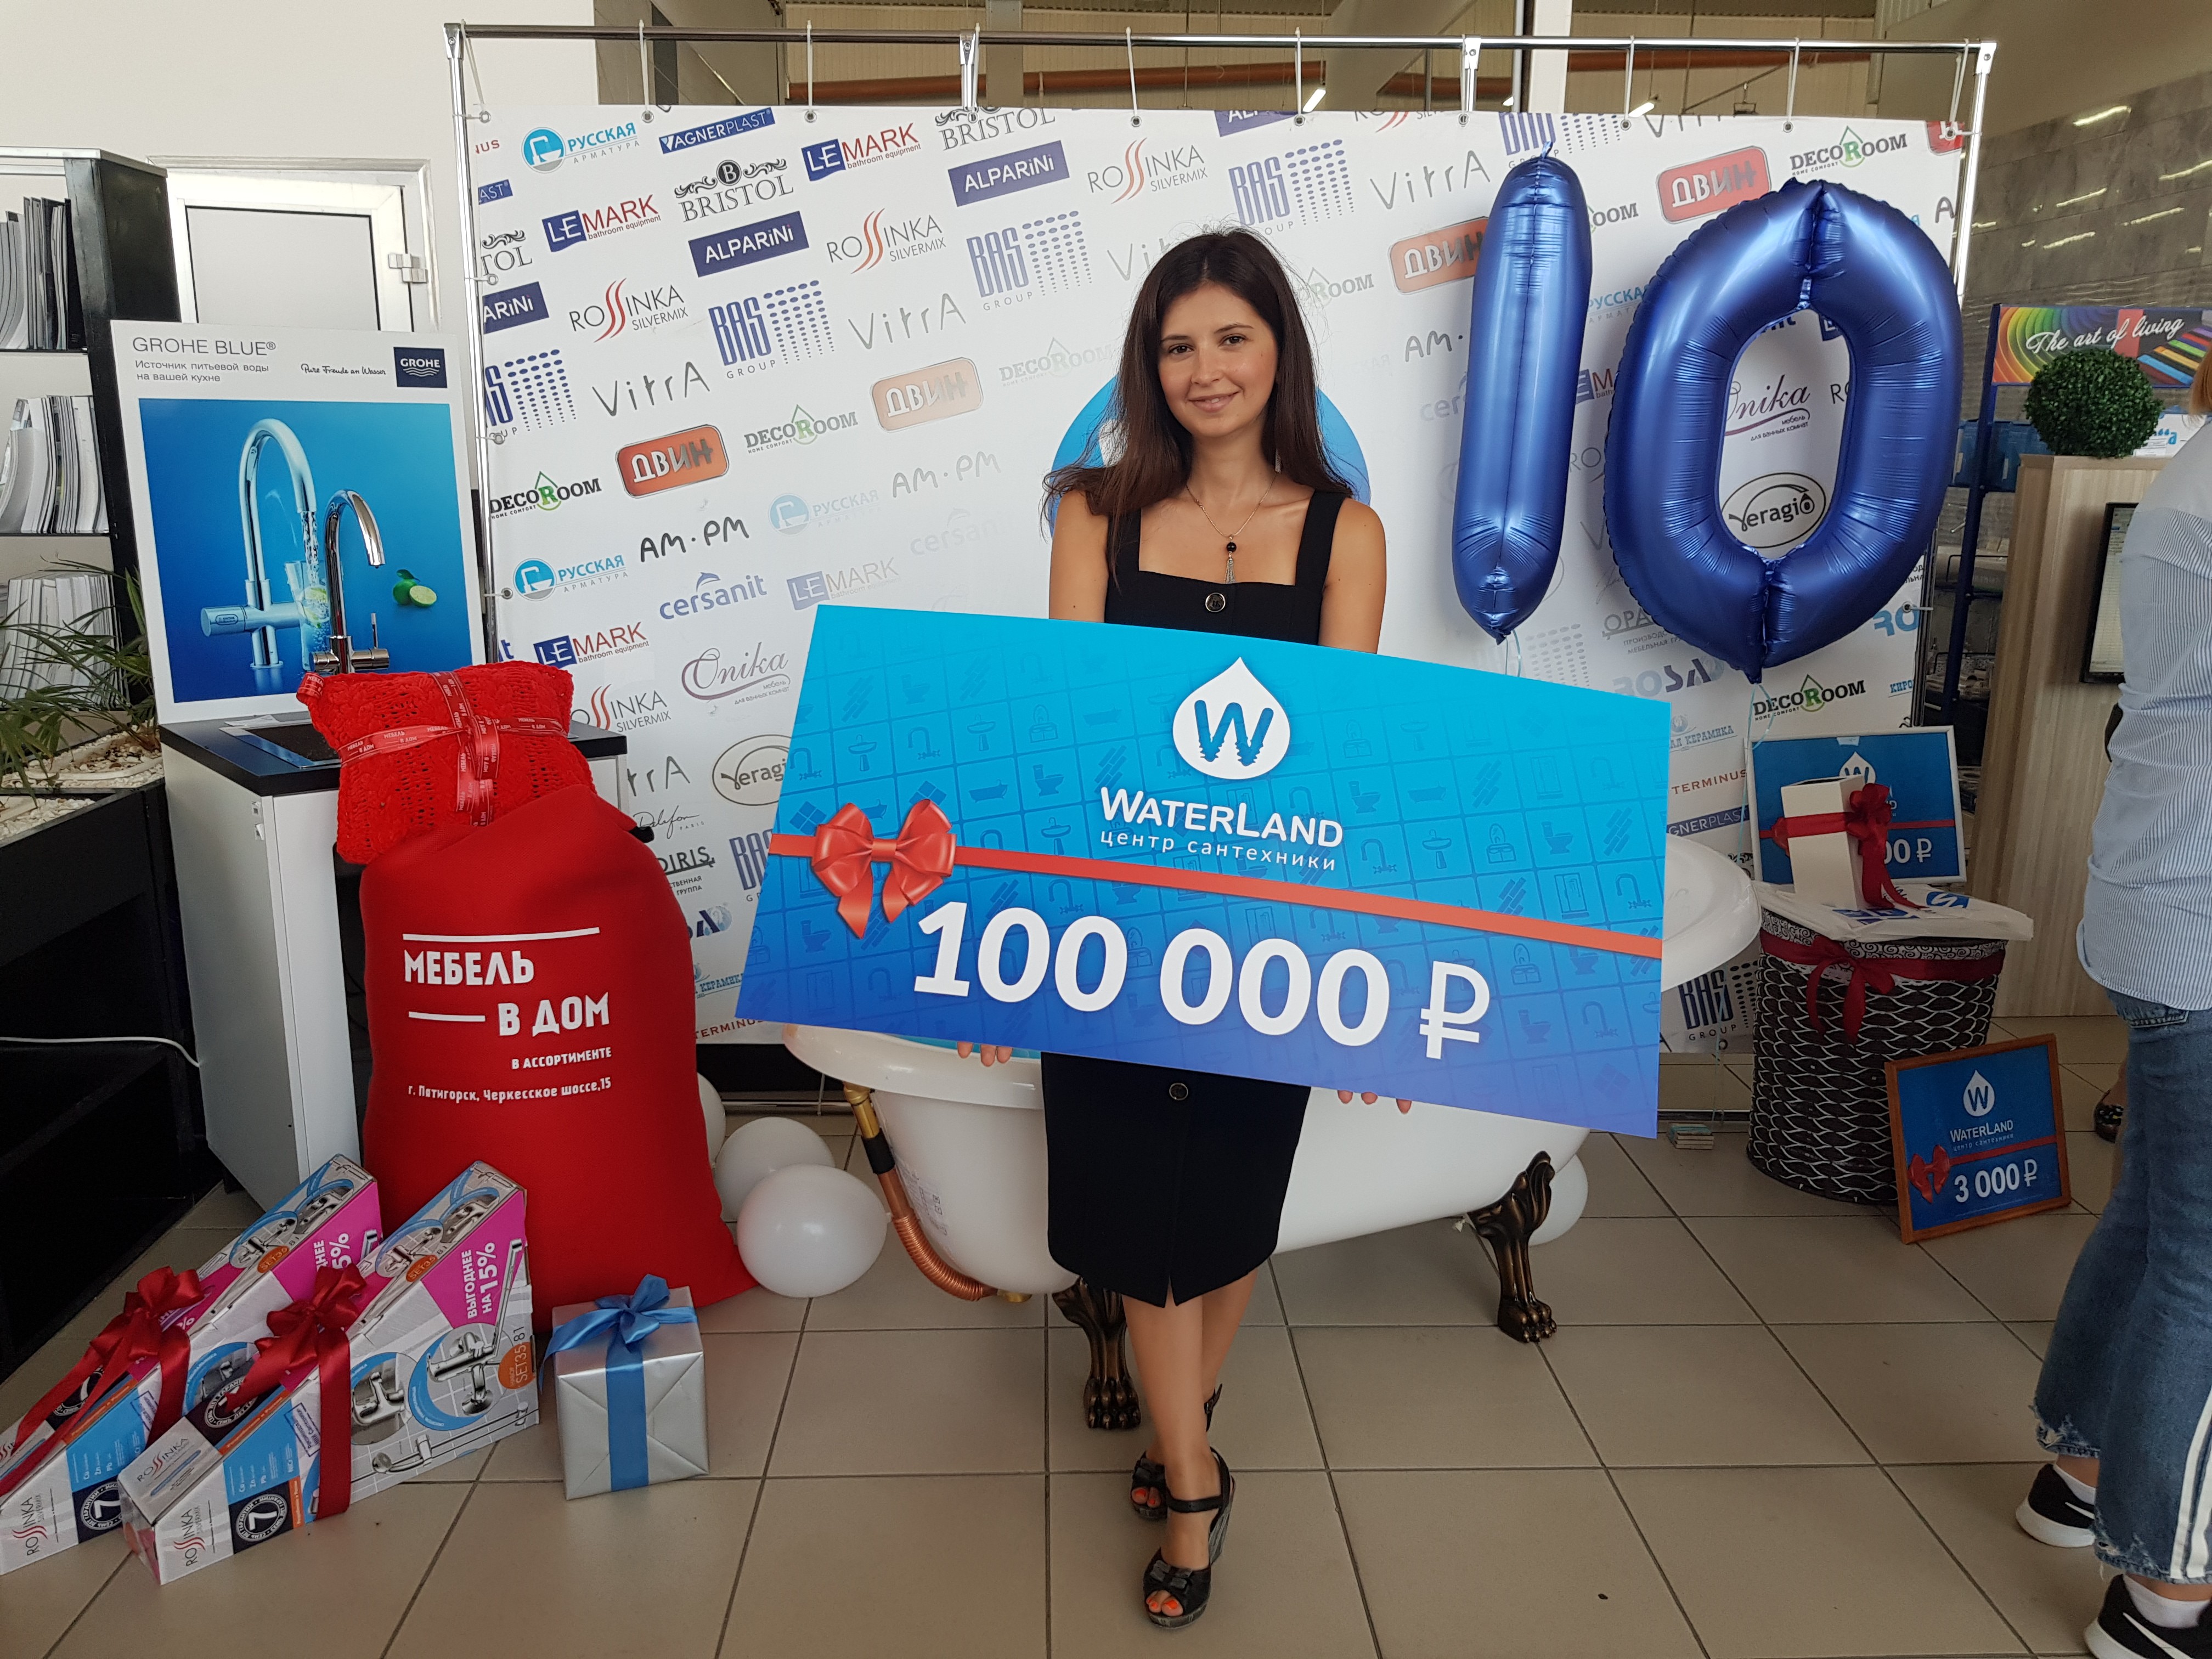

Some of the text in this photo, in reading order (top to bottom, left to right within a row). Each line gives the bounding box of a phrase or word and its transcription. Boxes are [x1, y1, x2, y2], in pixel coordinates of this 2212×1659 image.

[567, 122, 637, 152] РУССКАЯ
[939, 109, 1056, 150] BRISTOL
[573, 140, 640, 164] АРМАТУРА
[806, 123, 919, 172] LEMARK
[847, 143, 922, 169] bathroom equipment
[1150, 167, 1207, 192] SILVERMIX
[1370, 150, 1491, 210] VitrA
[1792, 161, 1839, 177] HOME COMFORT
[1672, 161, 1757, 208] ДВИН
[678, 174, 794, 222] BRISTOL
[547, 194, 659, 243] LEMARK
[588, 215, 661, 240] bathroom equipment
[1265, 221, 1294, 235] OUP
[889, 237, 946, 262] SILVERMIX
[983, 291, 1033, 312] GROUP
[632, 307, 689, 331] SILVERMIX
[848, 293, 966, 349] VitrA
[132, 337, 208, 355] GROHE
[2026, 315, 2185, 354] The art of living
[135, 360, 269, 373] Источник питьевой воды
[301, 363, 321, 374] Pure
[321, 365, 349, 375] Freude
[361, 366, 386, 375] Wasser
[400, 358, 441, 368] GROHE
[726, 359, 776, 380] GROUP
[153, 373, 188, 381] вашей
[190, 374, 221, 383] кухне
[592, 361, 710, 416] VitrA
[885, 371, 968, 417] ДВИН
[765, 439, 793, 450] COMFORT
[631, 438, 713, 483] ДВИН
[491, 505, 537, 520] HOME COMFORT
[812, 489, 879, 517] РУССКАЯ
[558, 554, 625, 582] РУССКАЯ
[792, 557, 899, 602] LEMARK
[563, 571, 628, 593] АРМАТУРА
[659, 574, 768, 619] cersanit
[538, 622, 647, 665] LEMARK
[578, 640, 650, 664] bathroom equipment
[1627, 639, 1668, 654] МЕБЕЛЬНАЯ
[307, 675, 324, 687] МЕБЕЛ
[682, 641, 789, 700] Onika
[571, 684, 668, 731] OSSINKA
[617, 710, 672, 733] SILVERMIX
[1194, 699, 1274, 767] W
[347, 741, 364, 751] МЕБЕЛЬ
[363, 743, 375, 752] ДОМ
[383, 730, 405, 740] МЕБЕЛЬ
[1685, 725, 1734, 745] КЕРАМИКА
[627, 755, 691, 798] trA
[1671, 769, 1746, 795] TERMINUS
[1668, 808, 1747, 836] GNERPLAST
[1100, 830, 1335, 872] центр сантехники
[676, 885, 703, 895] ГРУППА
[404, 949, 534, 986] МЕБЕЛЬ
[913, 900, 1491, 1060] 100 000 ₽
[497, 991, 611, 1037] В ДОМ
[695, 1019, 765, 1039] TERMINU
[1689, 1024, 1737, 1041] GROUP
[512, 1046, 612, 1070] В АССОРТИМЕНТЕ
[408, 1085, 416, 1096] г.
[418, 1085, 480, 1104] Пятигорск,
[483, 1087, 558, 1104] Черкесское
[1953, 1133, 2014, 1152] центр сантехники
[1954, 1175, 1970, 1203] 3
[1975, 1163, 2021, 1198] 000
[329, 1233, 352, 1269] 5%
[461, 1249, 477, 1319] ВЫГОДНЕЕ
[249, 1510, 278, 1531] 7
